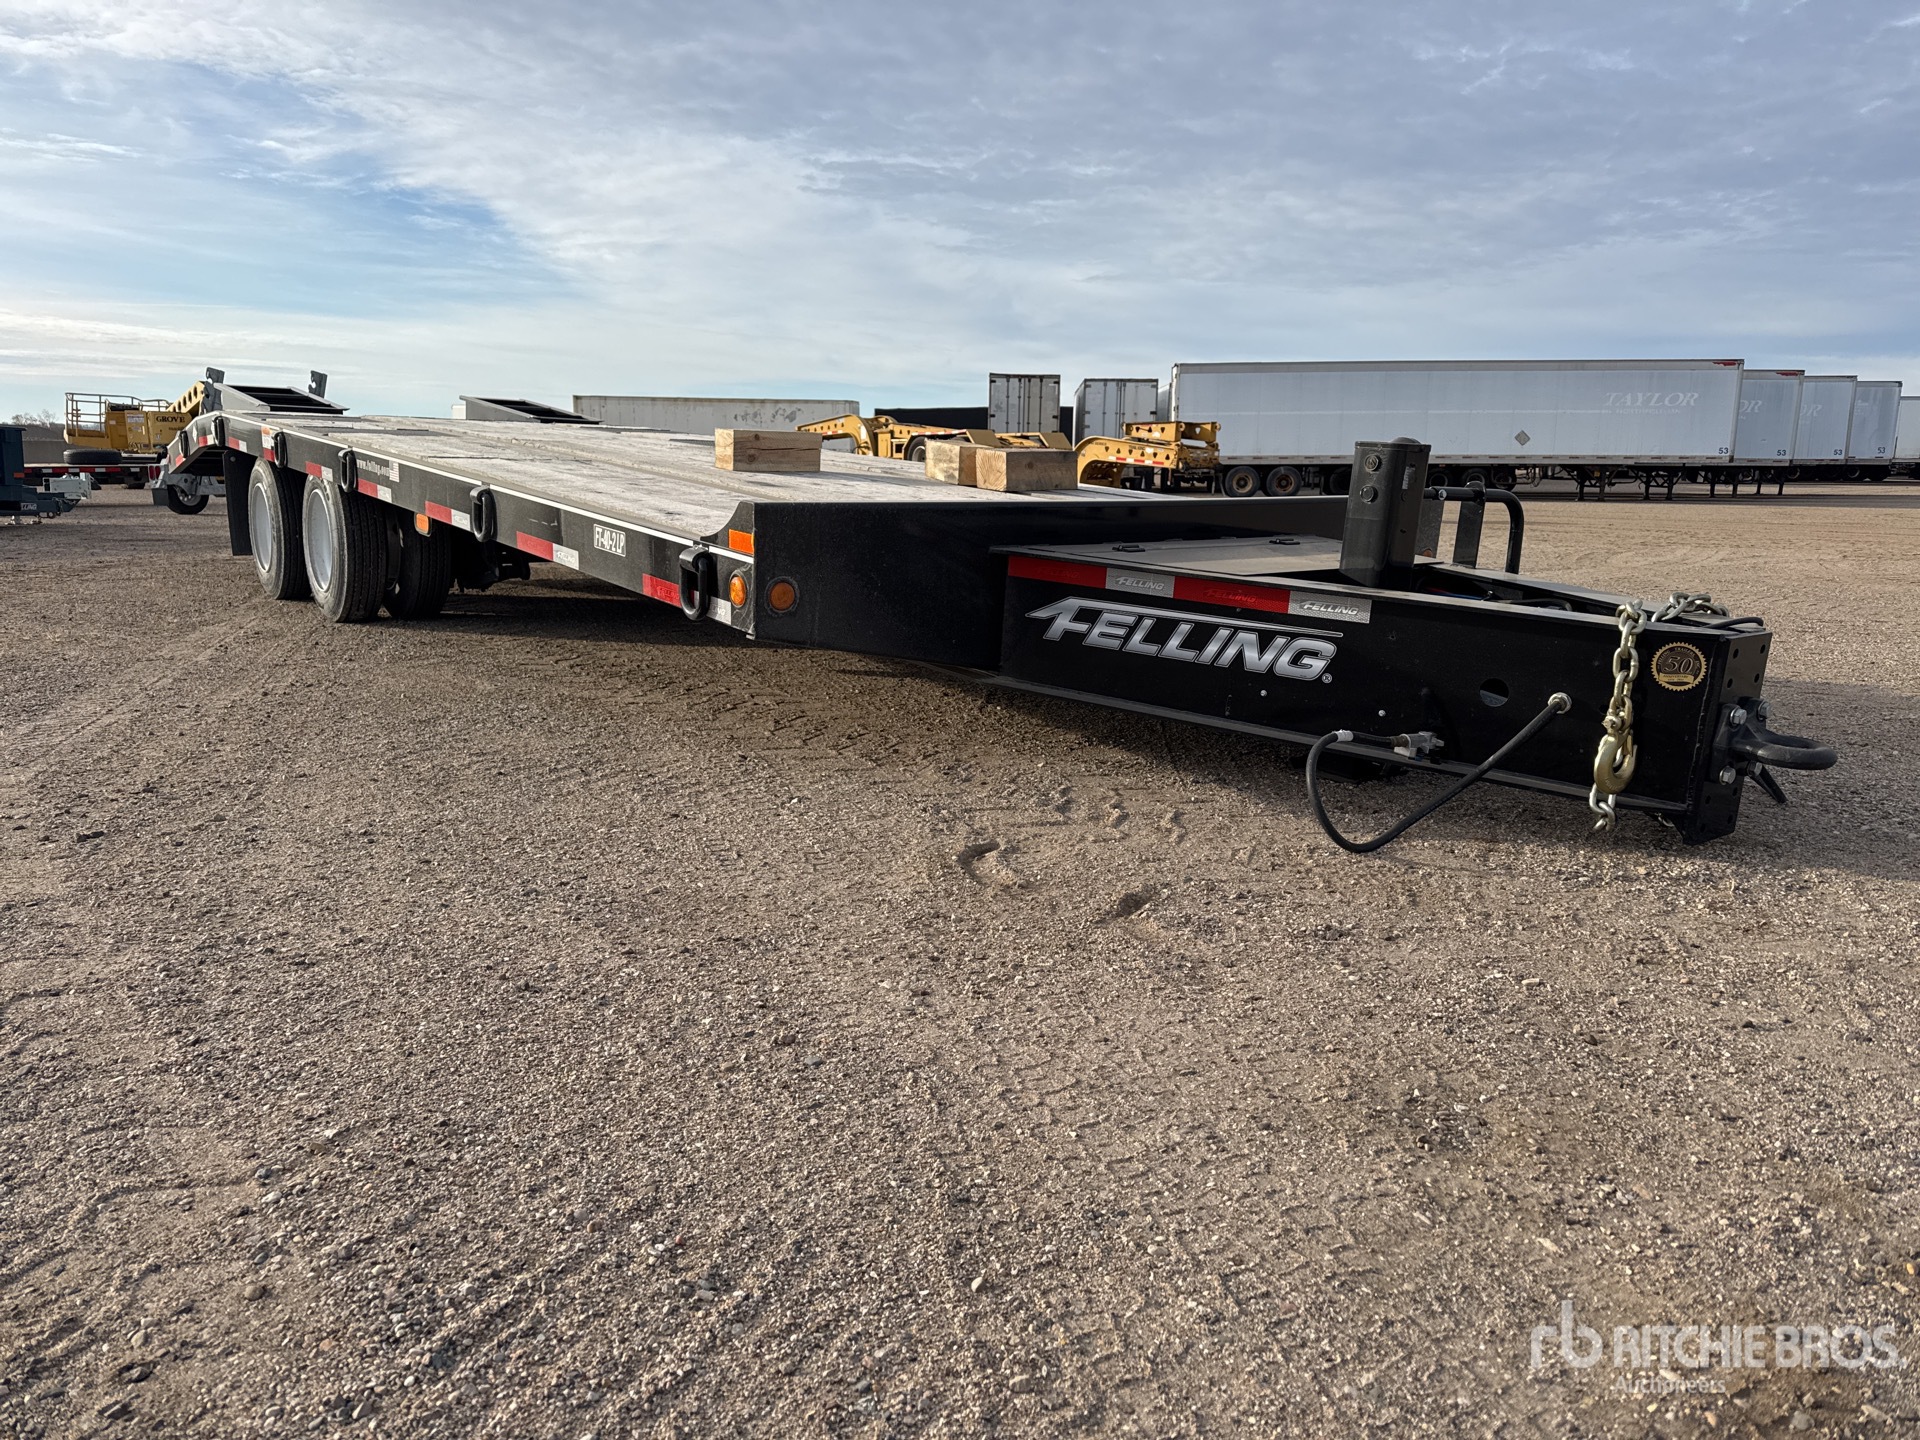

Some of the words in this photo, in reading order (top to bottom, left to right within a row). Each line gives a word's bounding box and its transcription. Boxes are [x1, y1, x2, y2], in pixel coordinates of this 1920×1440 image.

[1602, 392, 1699, 407] TAYLOR
[155, 415, 186, 423] GROVE
[1718, 447, 1729, 455] 53
[1776, 449, 1787, 457] 53
[1877, 446, 1886, 454] 53
[1114, 575, 1165, 591] FELLING
[1203, 588, 1257, 604] FELLING
[1300, 599, 1359, 617] FELLING
[1025, 596, 1343, 681] FELLING
[1663, 655, 1694, 674] 50
